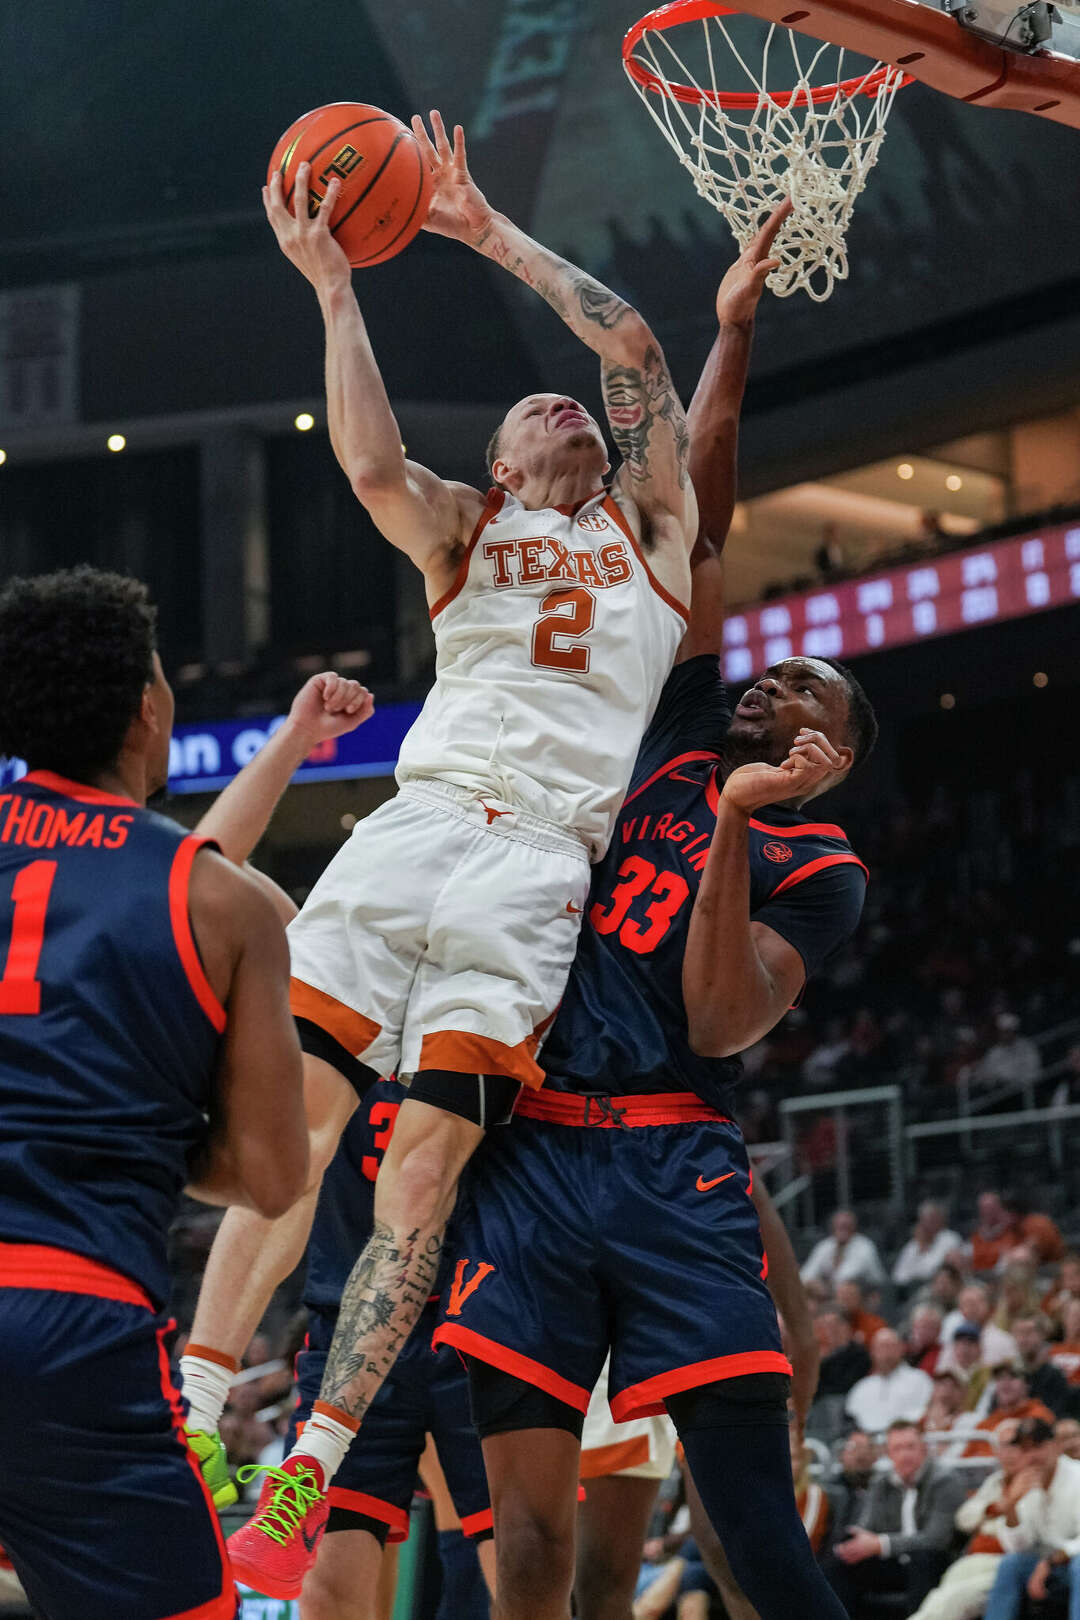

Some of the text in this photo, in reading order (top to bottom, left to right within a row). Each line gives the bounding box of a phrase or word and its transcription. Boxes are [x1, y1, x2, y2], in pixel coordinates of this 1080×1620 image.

[304, 144, 364, 219] ELIT
[482, 536, 635, 589] TEXAS
[530, 586, 597, 673] 2
[622, 812, 712, 873] VIRGIN
[0, 859, 57, 1015] 1
[589, 855, 690, 955] 33
[445, 1258, 496, 1316] V
